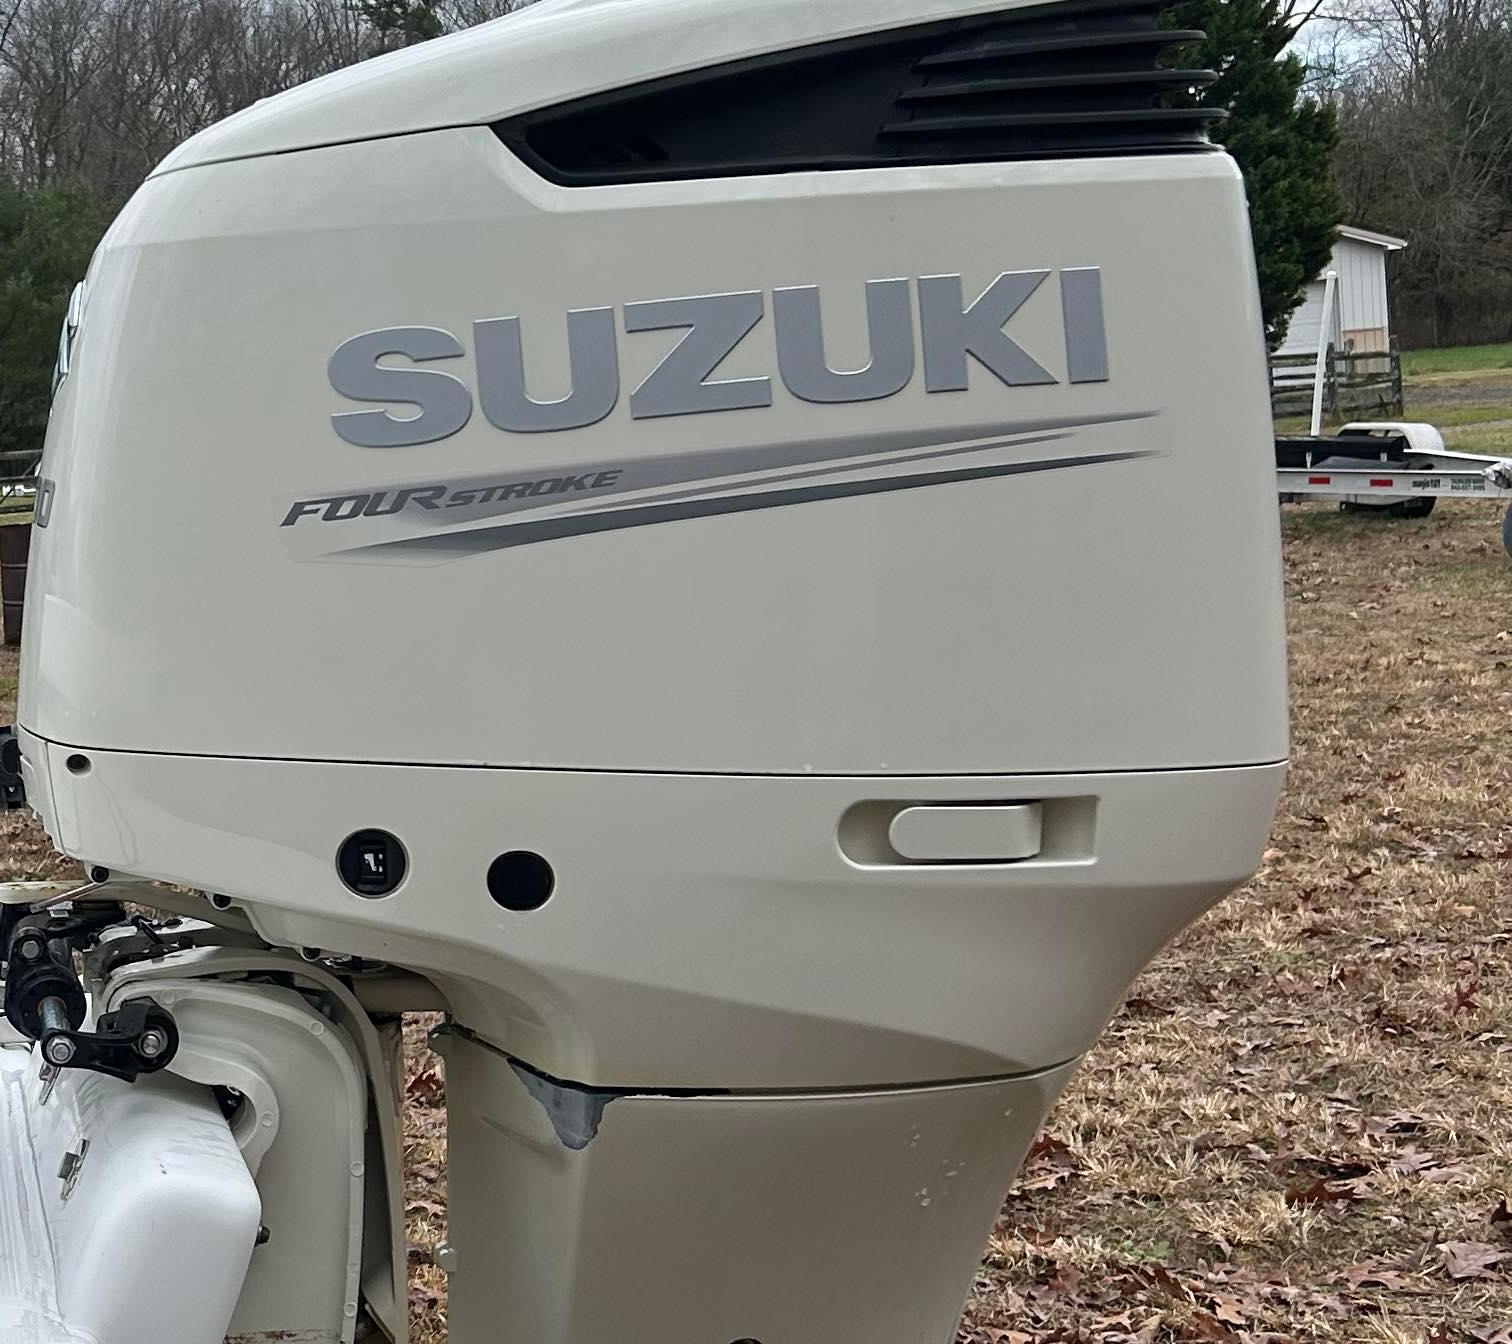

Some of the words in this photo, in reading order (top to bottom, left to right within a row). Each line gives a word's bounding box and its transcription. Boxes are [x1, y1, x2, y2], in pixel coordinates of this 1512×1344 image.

[326, 266, 1110, 449] SUZUKI
[279, 485, 449, 528] FOUR
[445, 469, 625, 508] STROKE
